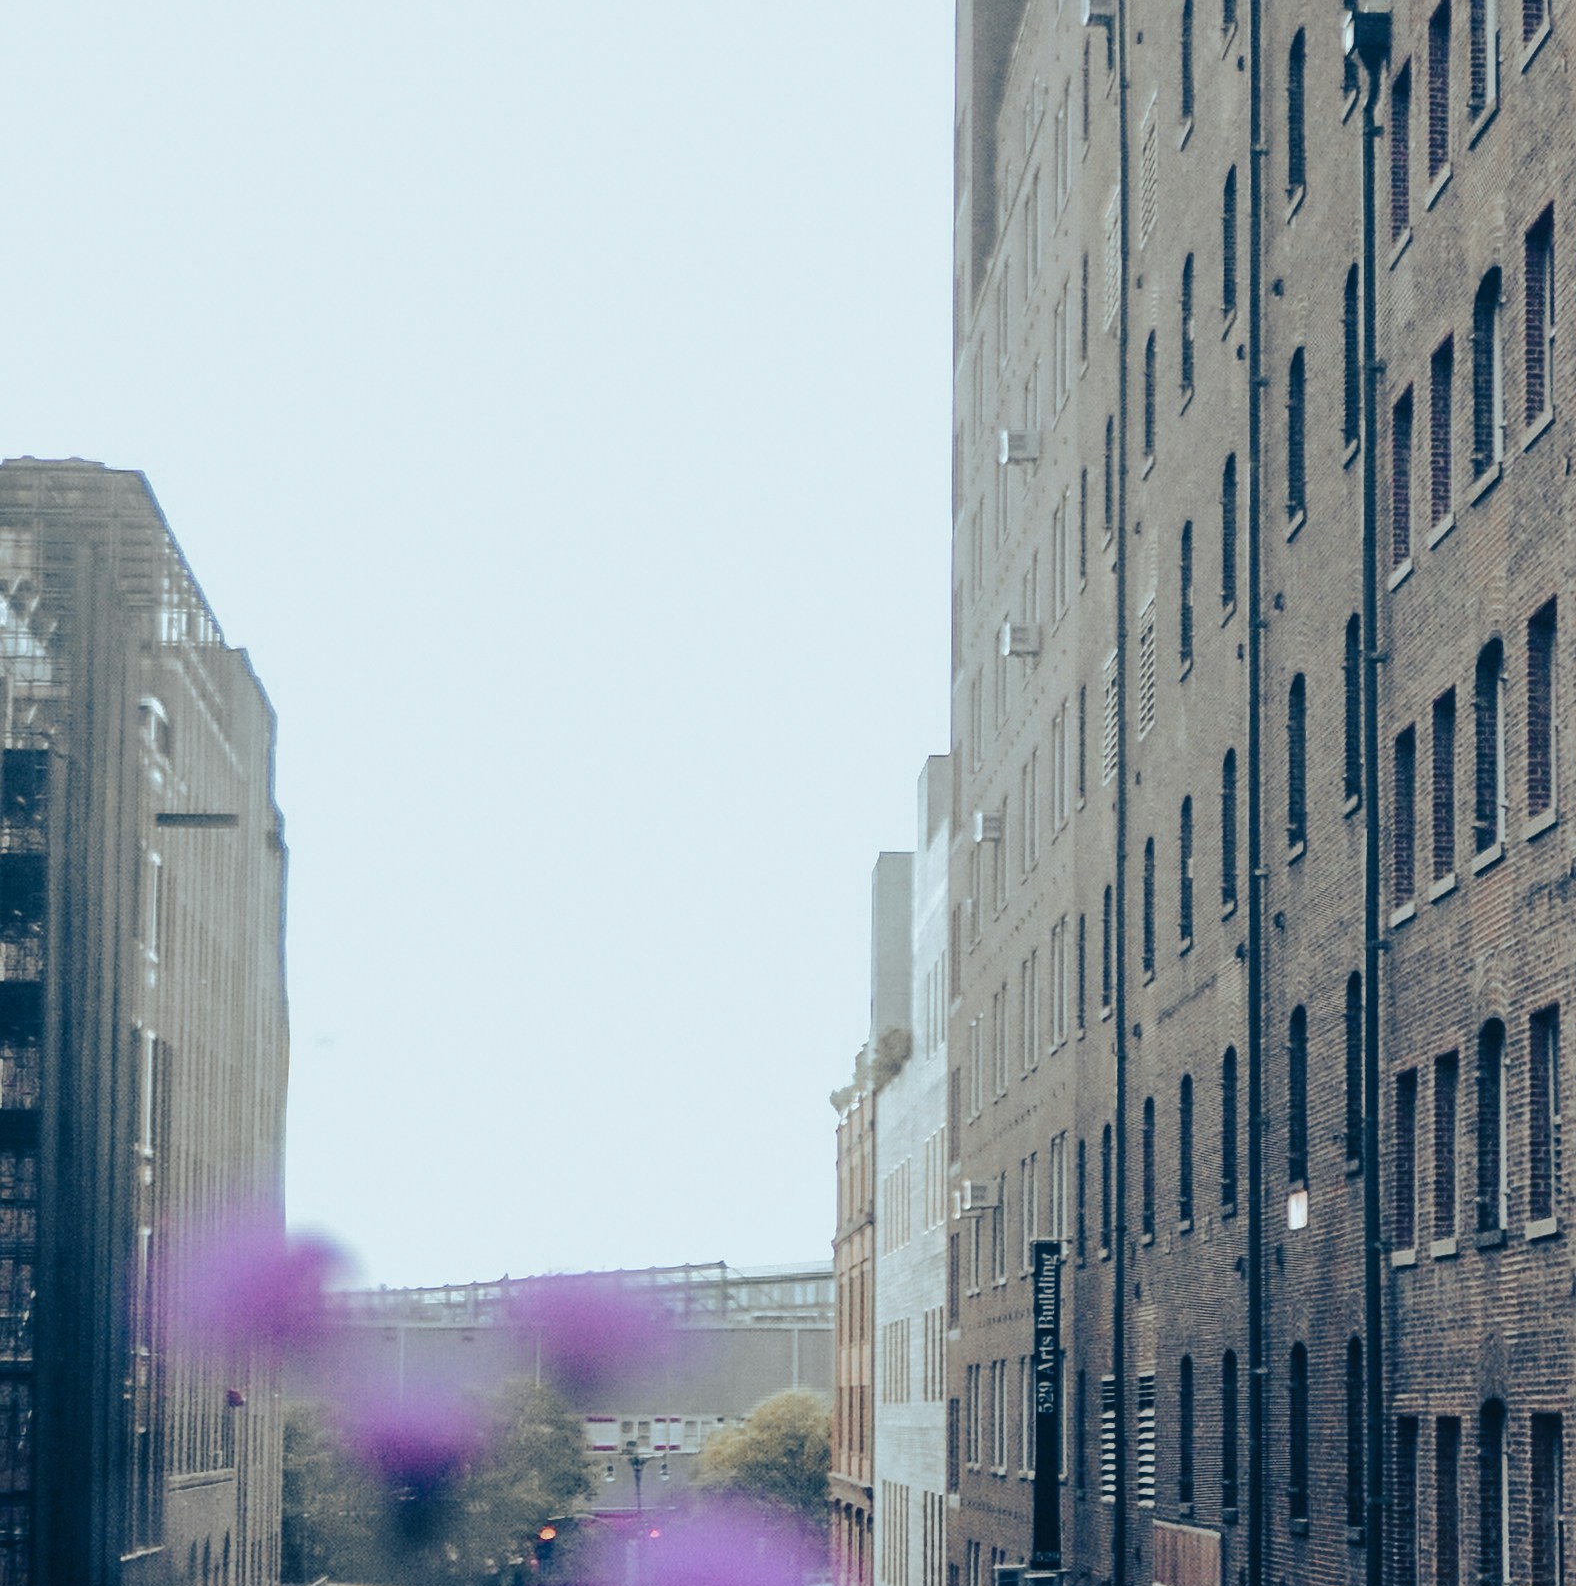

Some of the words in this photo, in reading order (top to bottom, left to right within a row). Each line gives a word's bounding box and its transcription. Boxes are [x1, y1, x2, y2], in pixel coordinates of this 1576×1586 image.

[1037, 1252, 1059, 1329] Building
[1037, 1334, 1055, 1374] Arts
[1038, 1380, 1055, 1414] 529
